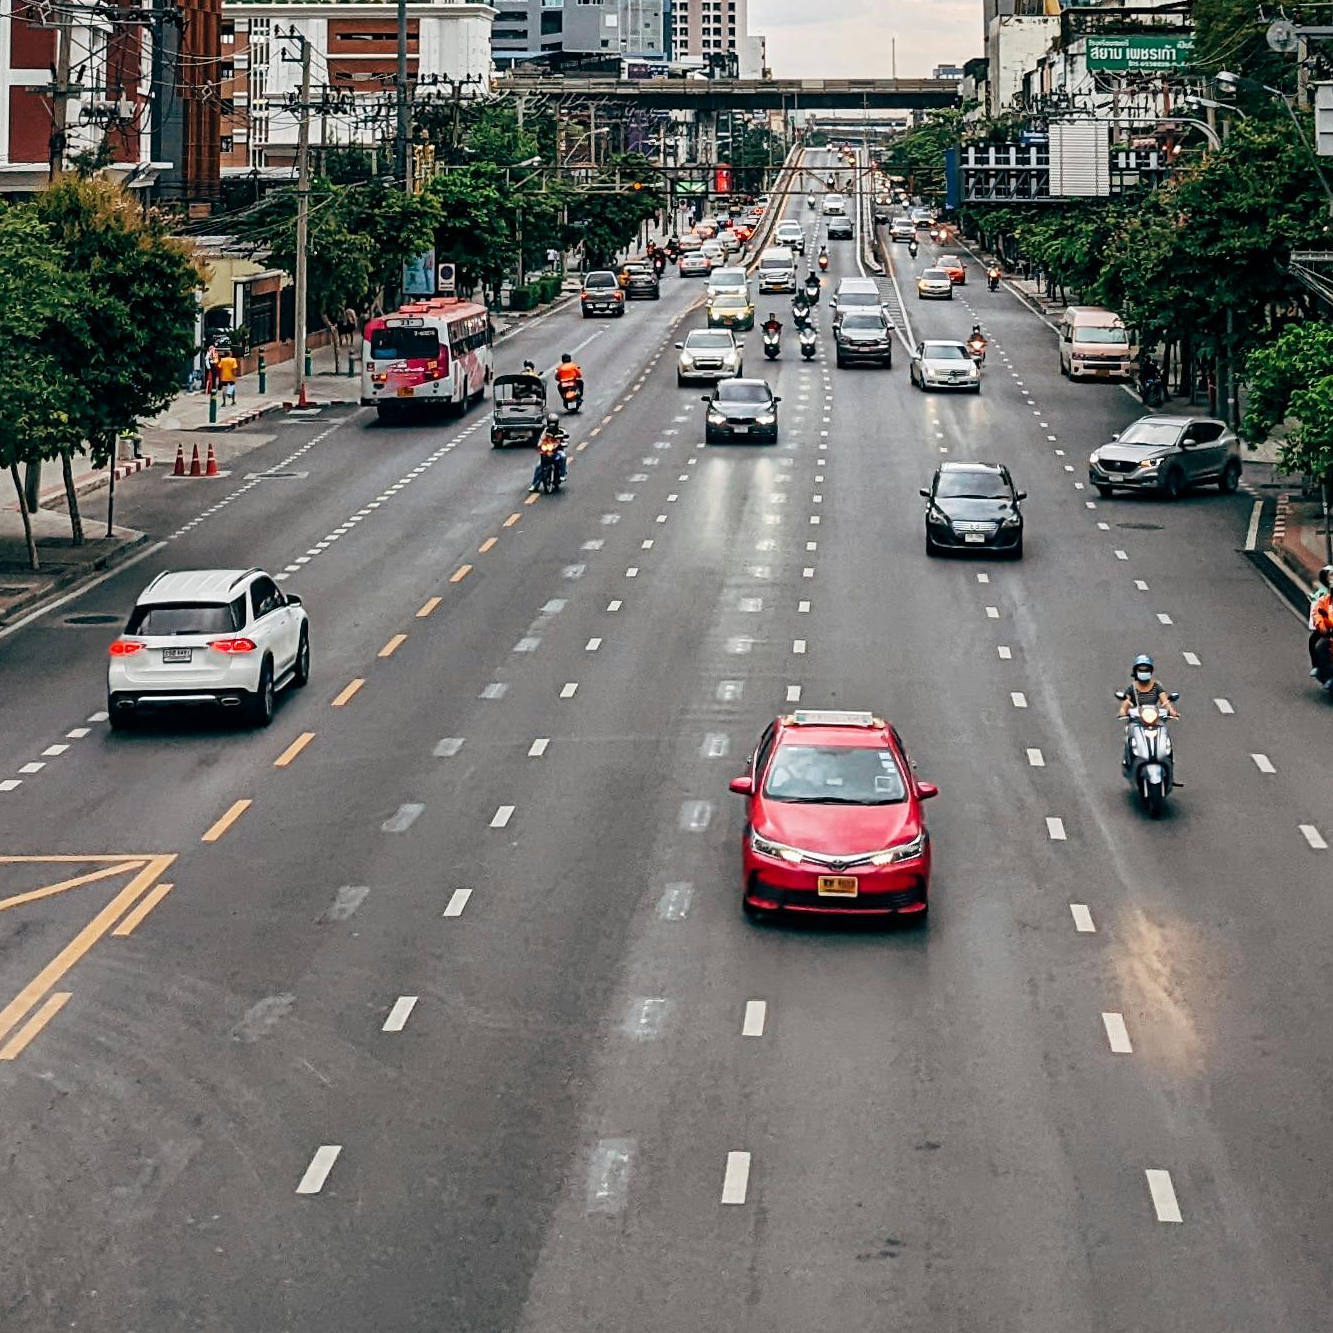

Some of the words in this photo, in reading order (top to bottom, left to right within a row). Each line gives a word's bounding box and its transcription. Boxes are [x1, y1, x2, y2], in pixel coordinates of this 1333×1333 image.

[1090, 46, 1122, 60] สยาม
[1126, 44, 1176, 60] เพชรเก้า
